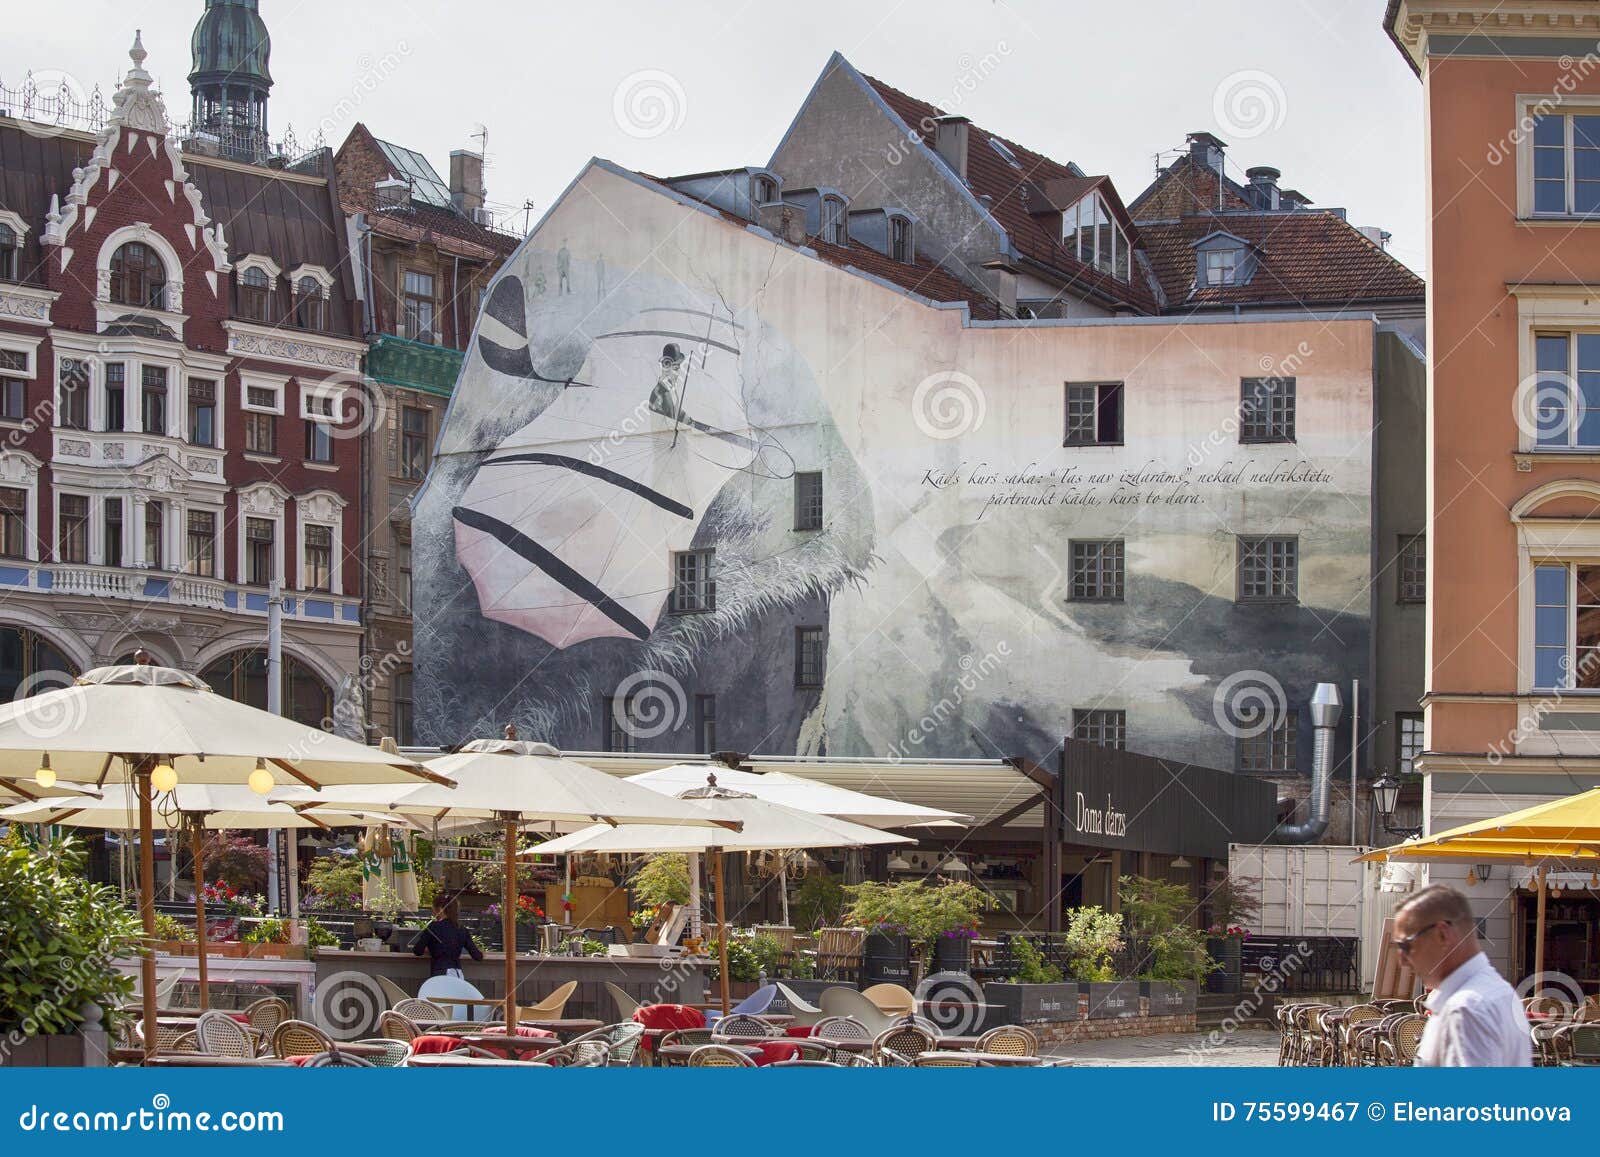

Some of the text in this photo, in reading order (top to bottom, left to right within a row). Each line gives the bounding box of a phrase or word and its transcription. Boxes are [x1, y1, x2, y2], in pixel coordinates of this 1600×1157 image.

[968, 463, 999, 485] kurš
[1002, 463, 1042, 485] saka:
[1088, 472, 1114, 484] nav
[1198, 460, 1255, 485] nekad
[976, 485, 1056, 521] pārtraukt
[1108, 487, 1139, 505] kurš
[1145, 490, 1161, 504] to
[1076, 791, 1126, 837] Doma dārzs
